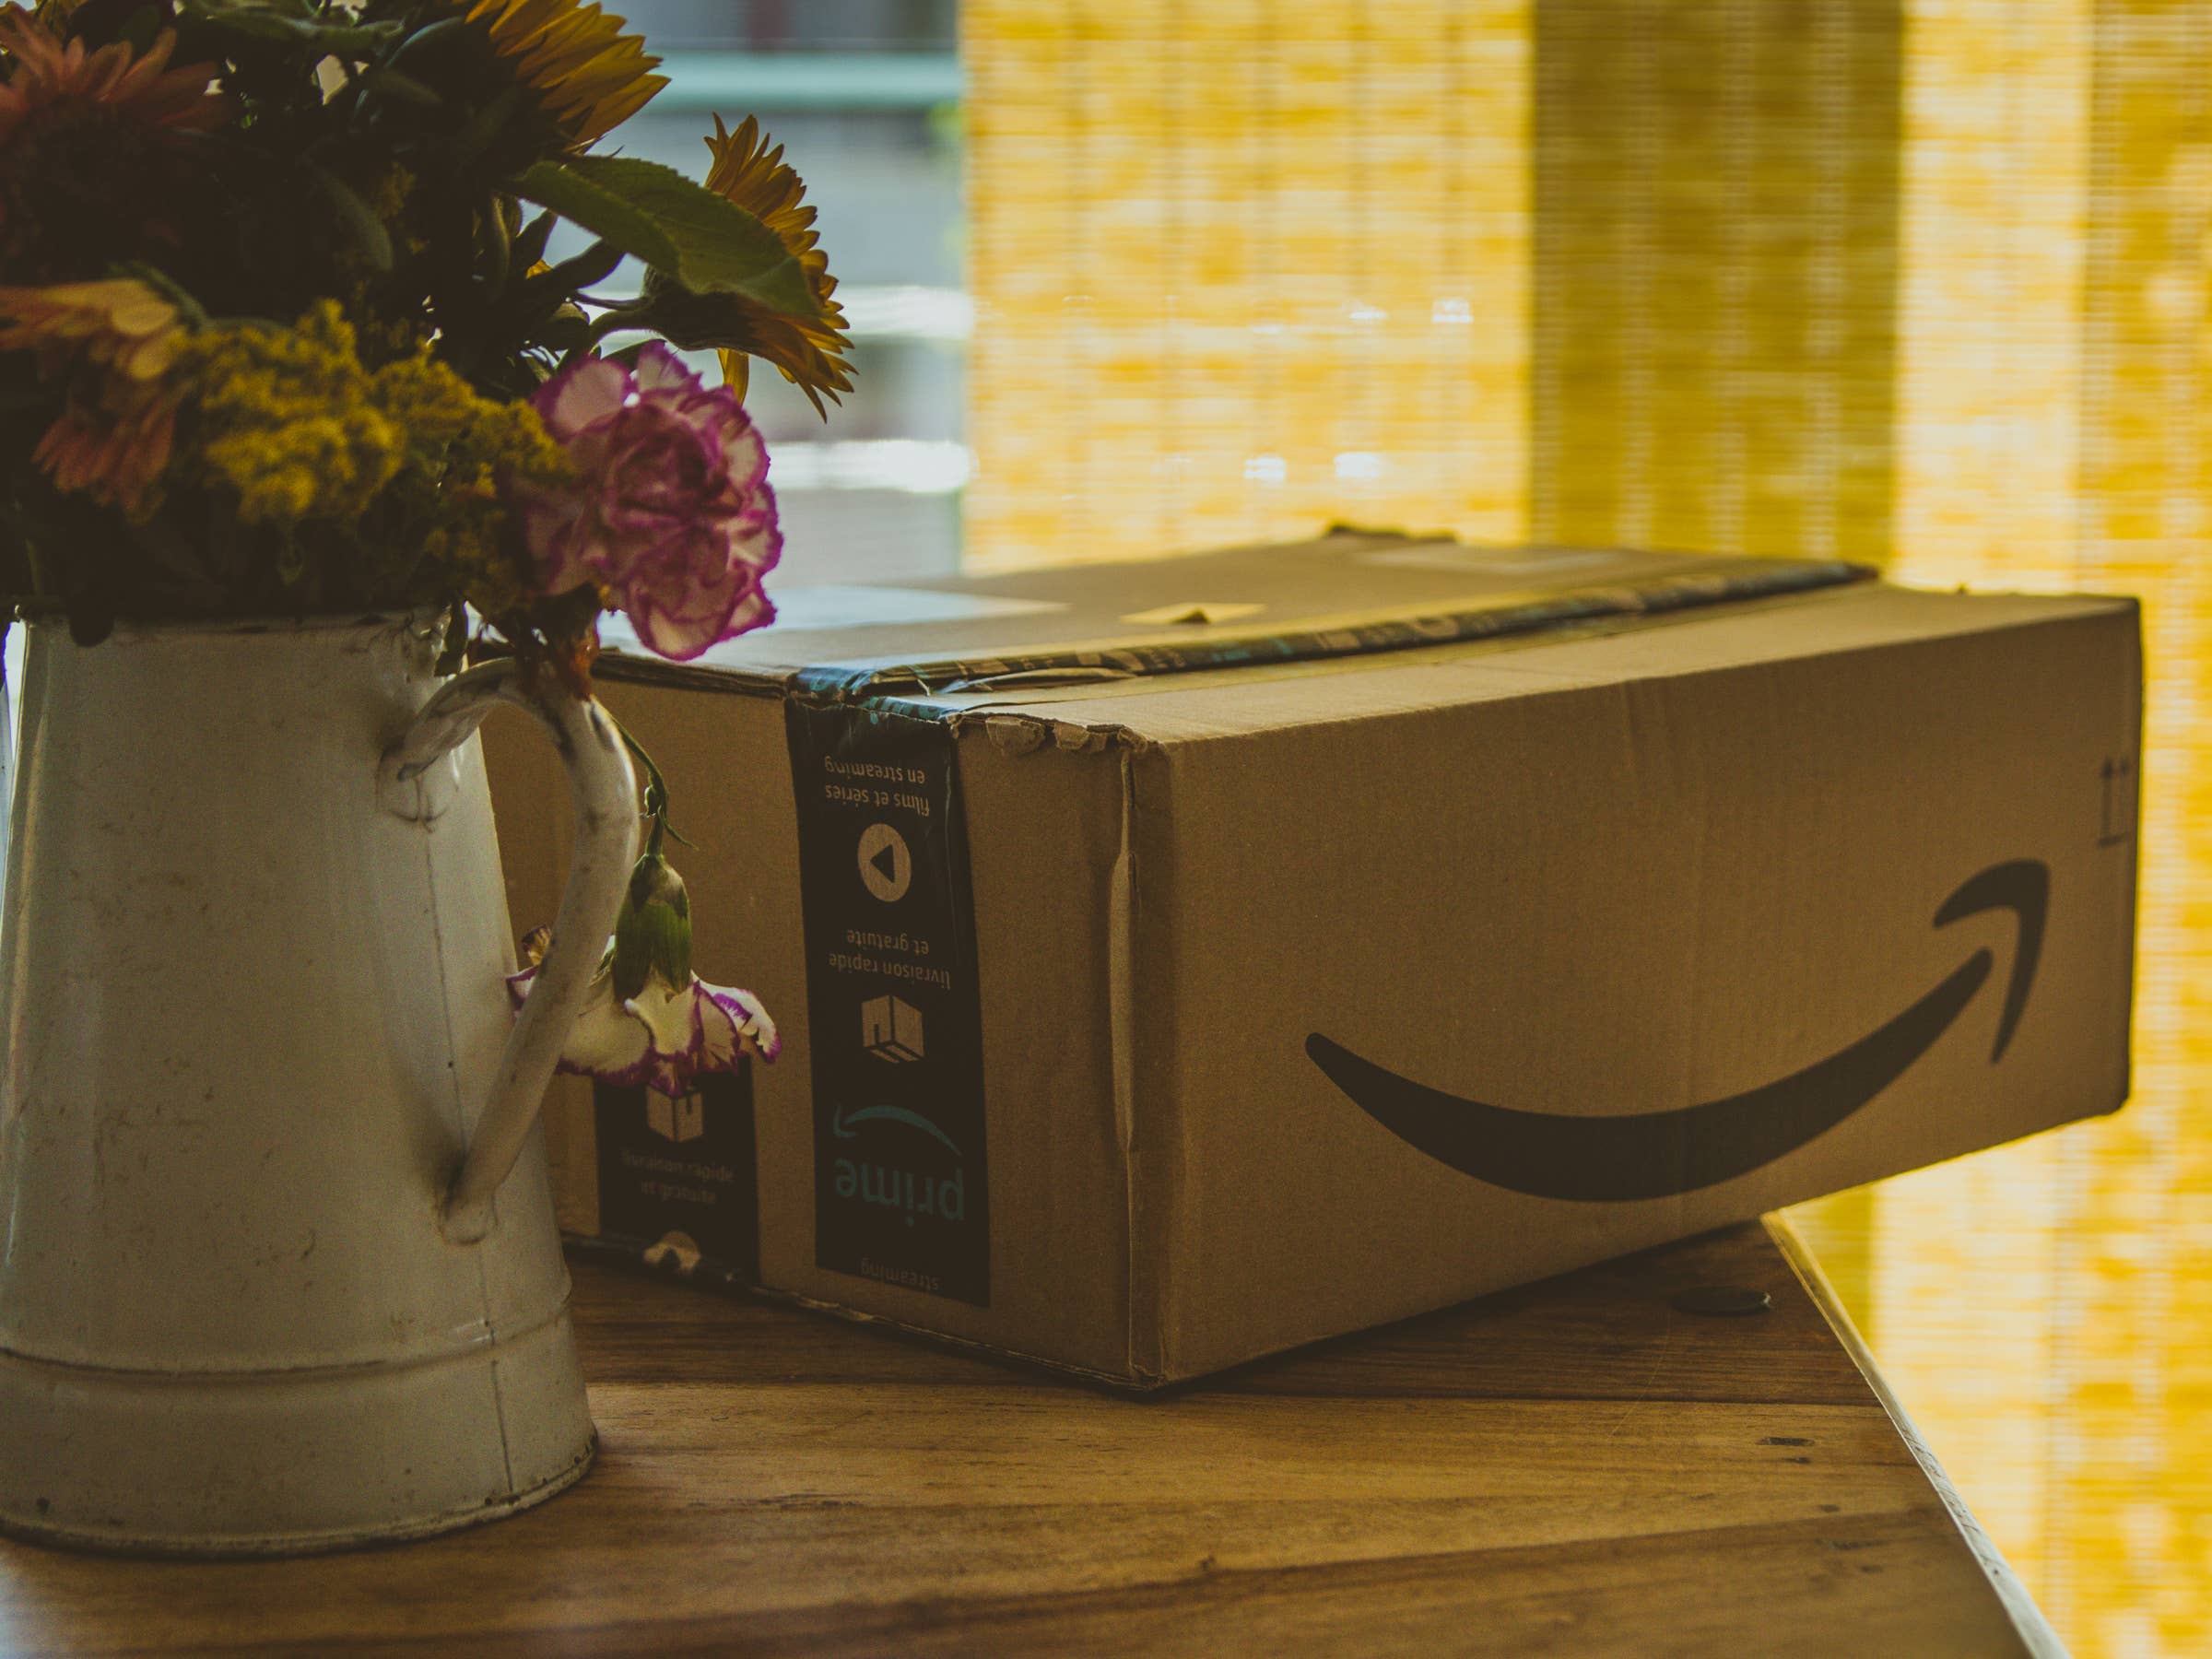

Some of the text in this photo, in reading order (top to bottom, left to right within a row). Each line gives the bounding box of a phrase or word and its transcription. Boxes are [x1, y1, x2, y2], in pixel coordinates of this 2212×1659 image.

[825, 754, 926, 784] en streaming
[825, 782, 931, 818] films et séries
[847, 928, 930, 959] et gratuite
[829, 952, 951, 991] livraison rapide
[834, 1157, 965, 1228] prime
